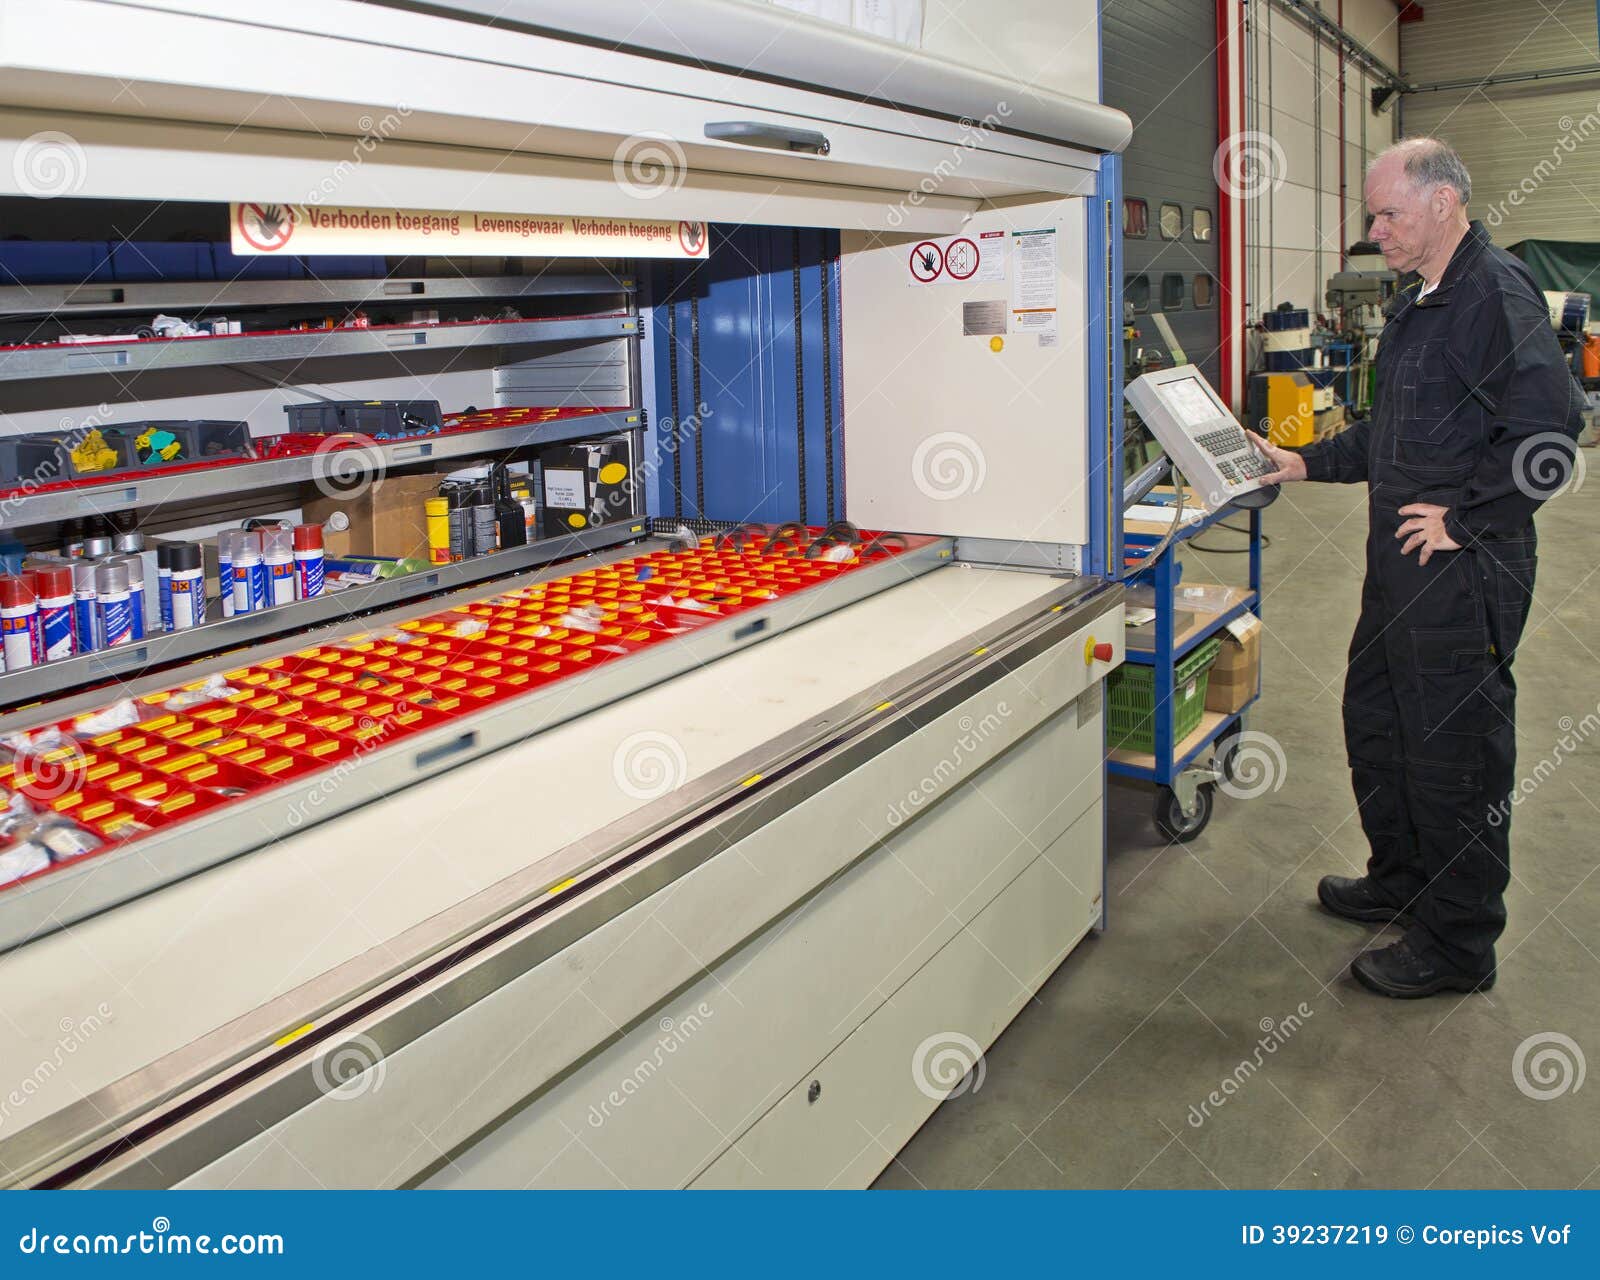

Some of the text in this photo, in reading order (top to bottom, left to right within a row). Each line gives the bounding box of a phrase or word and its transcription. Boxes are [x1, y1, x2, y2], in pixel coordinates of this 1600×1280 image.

[308, 208, 673, 242] Verboden toegang Levensgevaar Verboden toegang
